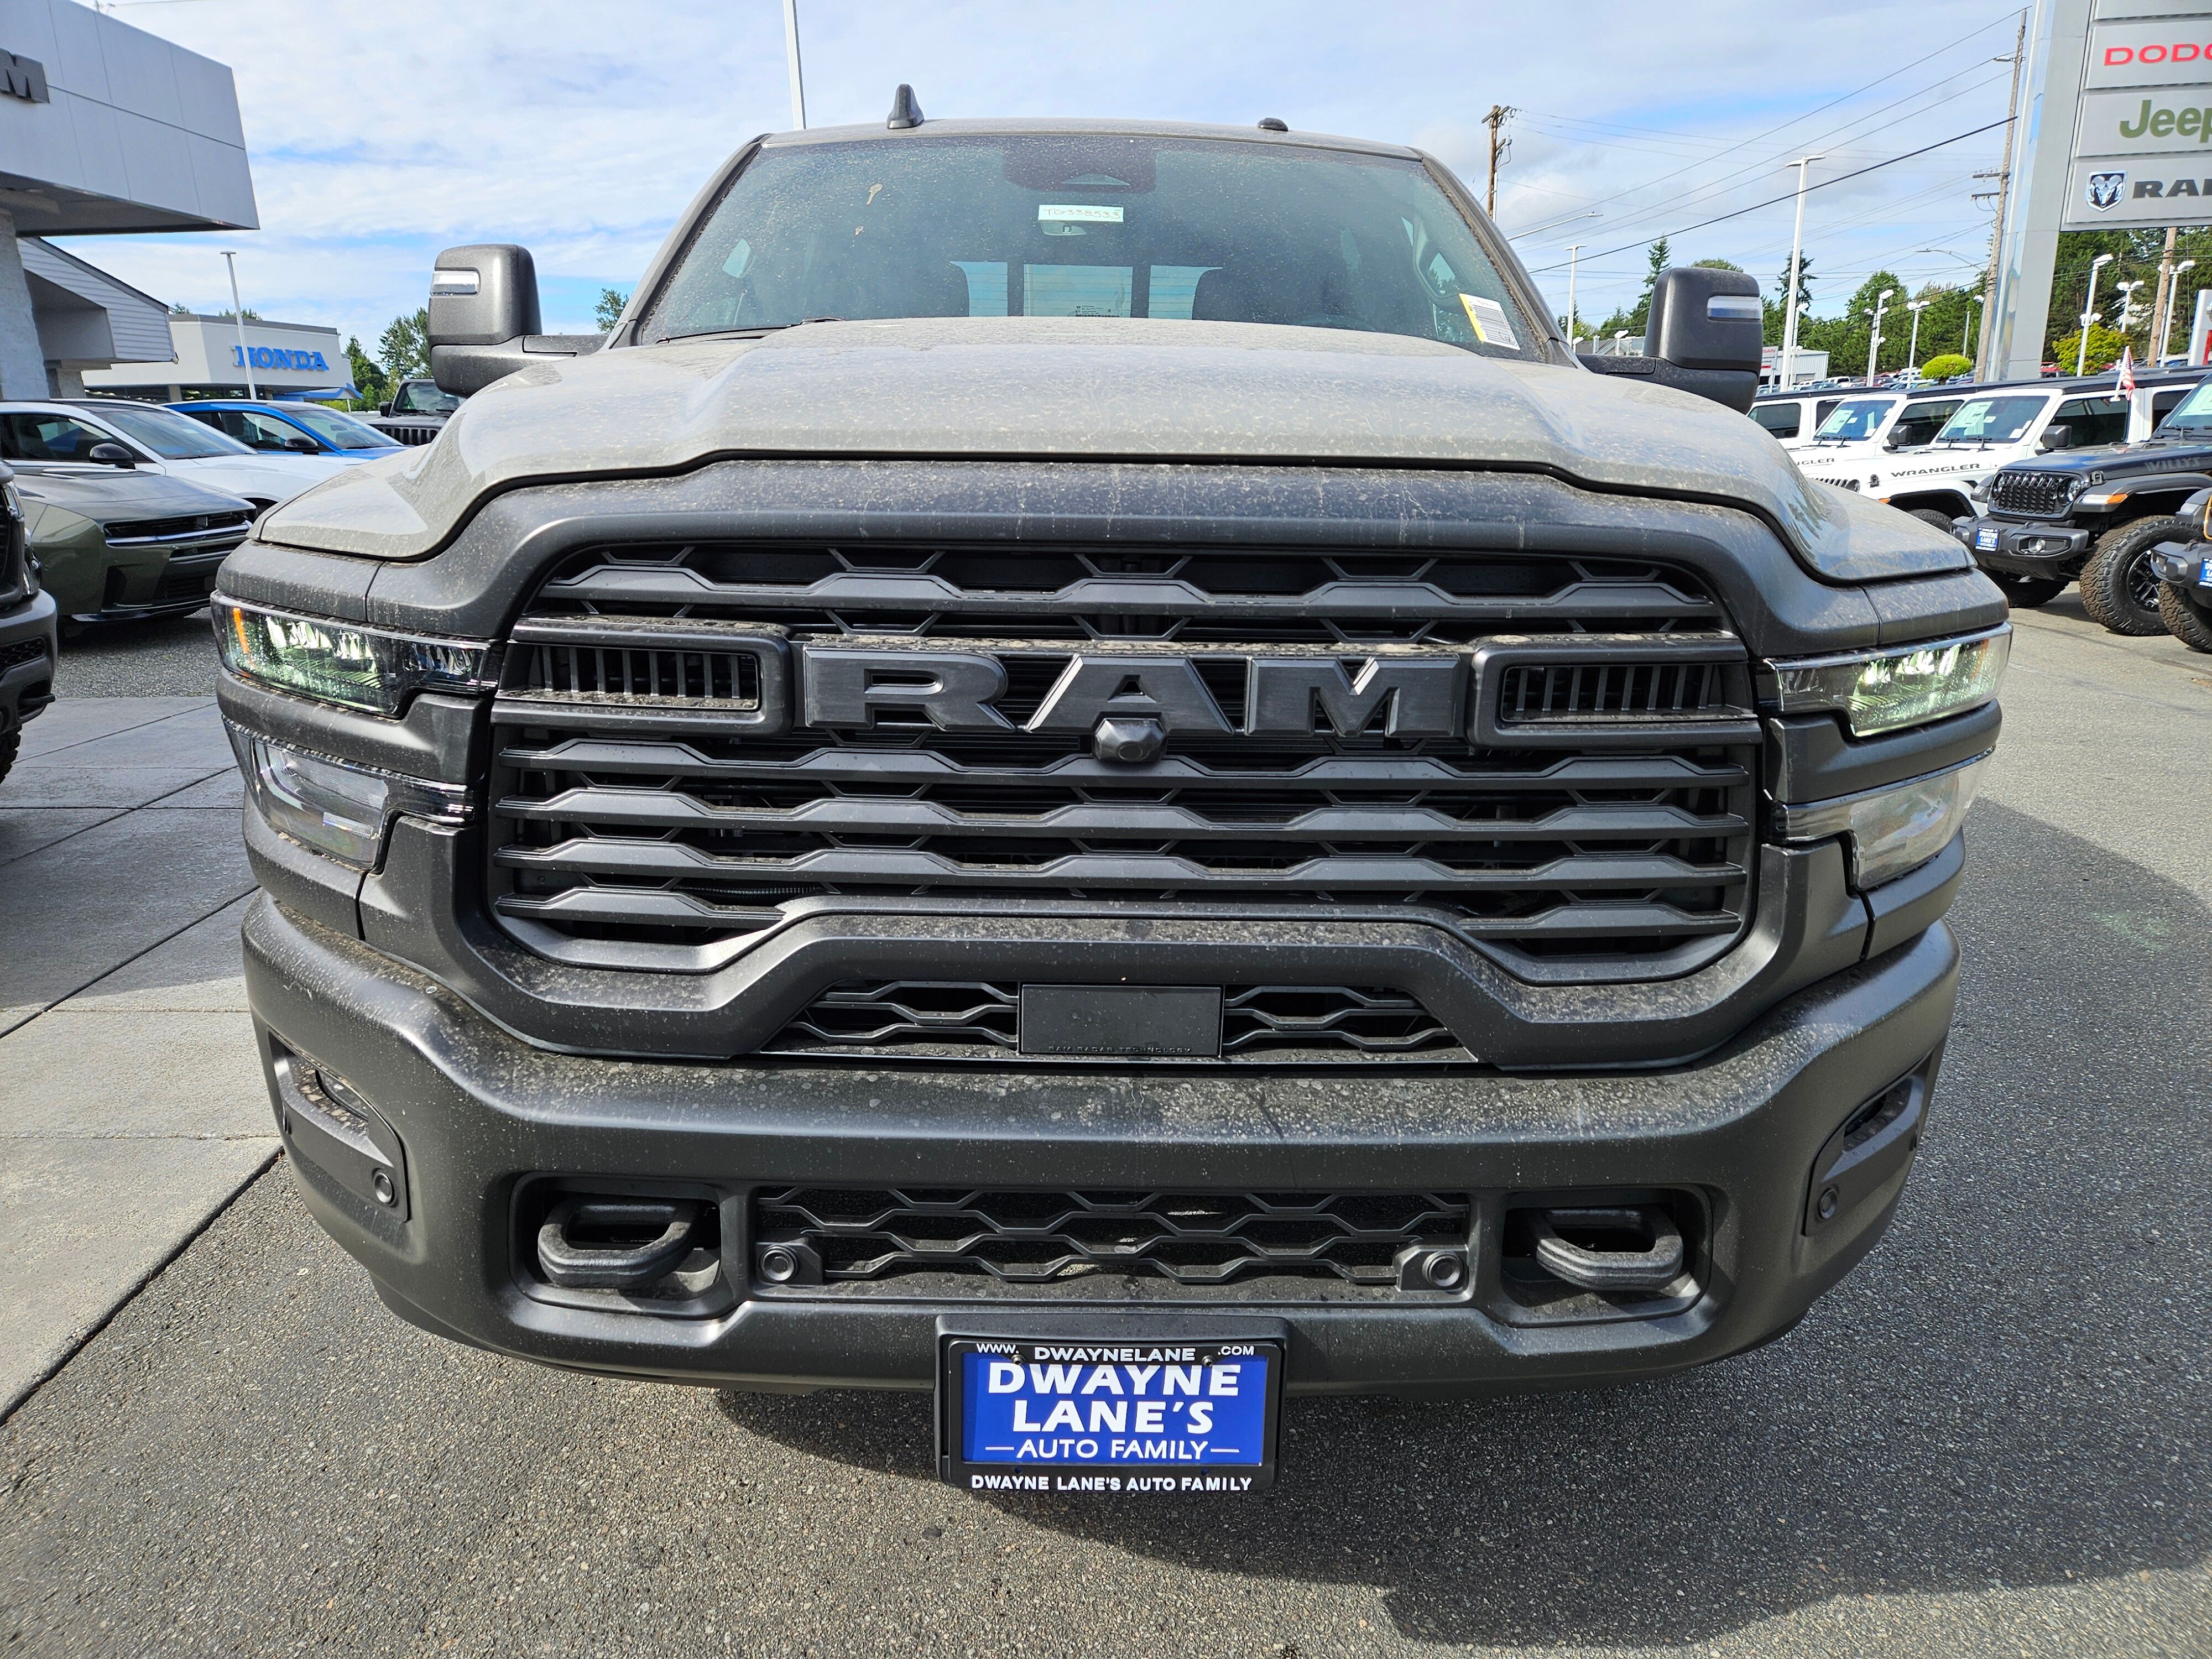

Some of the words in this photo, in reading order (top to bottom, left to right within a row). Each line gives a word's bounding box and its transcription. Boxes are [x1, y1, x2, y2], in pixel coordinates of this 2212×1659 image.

[2104, 43, 2212, 66] DOD
[234, 346, 330, 371] HONDA
[1891, 463, 1980, 477] WRANGLER
[2145, 457, 2200, 472] WILLYS
[804, 643, 1460, 737] RAM
[976, 1343, 1019, 1354] WWW.
[1035, 1347, 1196, 1362] DWAYNELANE
[1218, 1345, 1255, 1357] .COM
[988, 1362, 1241, 1396] DWAYNE
[1013, 1400, 1214, 1434] LANE'S
[1016, 1439, 1099, 1459] AUTO
[1111, 1439, 1208, 1460] FAMILY
[971, 1475, 1050, 1490] DWAYNE
[1057, 1476, 1121, 1491] LANE'S
[1126, 1477, 1176, 1492] AUTO
[1182, 1477, 1253, 1492] FAMILY
